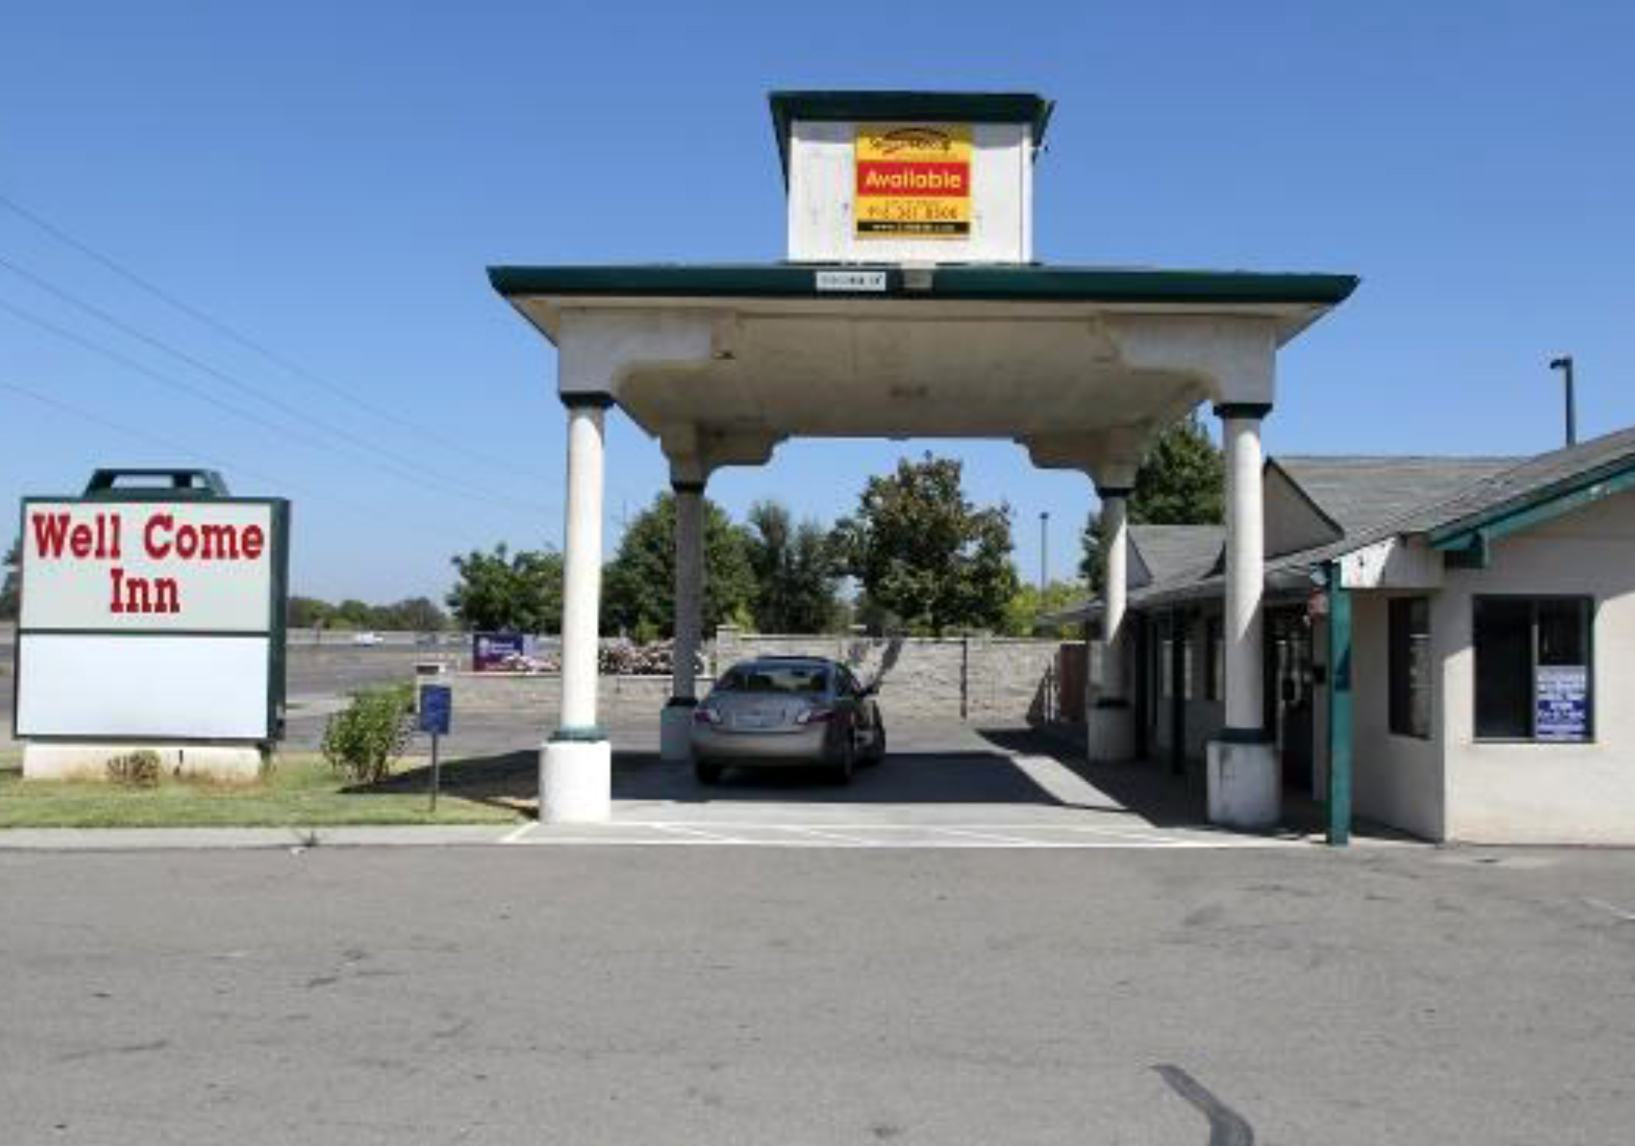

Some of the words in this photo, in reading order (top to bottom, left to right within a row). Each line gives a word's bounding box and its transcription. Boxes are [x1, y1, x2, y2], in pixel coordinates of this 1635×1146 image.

[865, 169, 962, 189] Available
[33, 513, 121, 559] Well
[144, 513, 264, 560] Come
[110, 568, 180, 613] Inn
